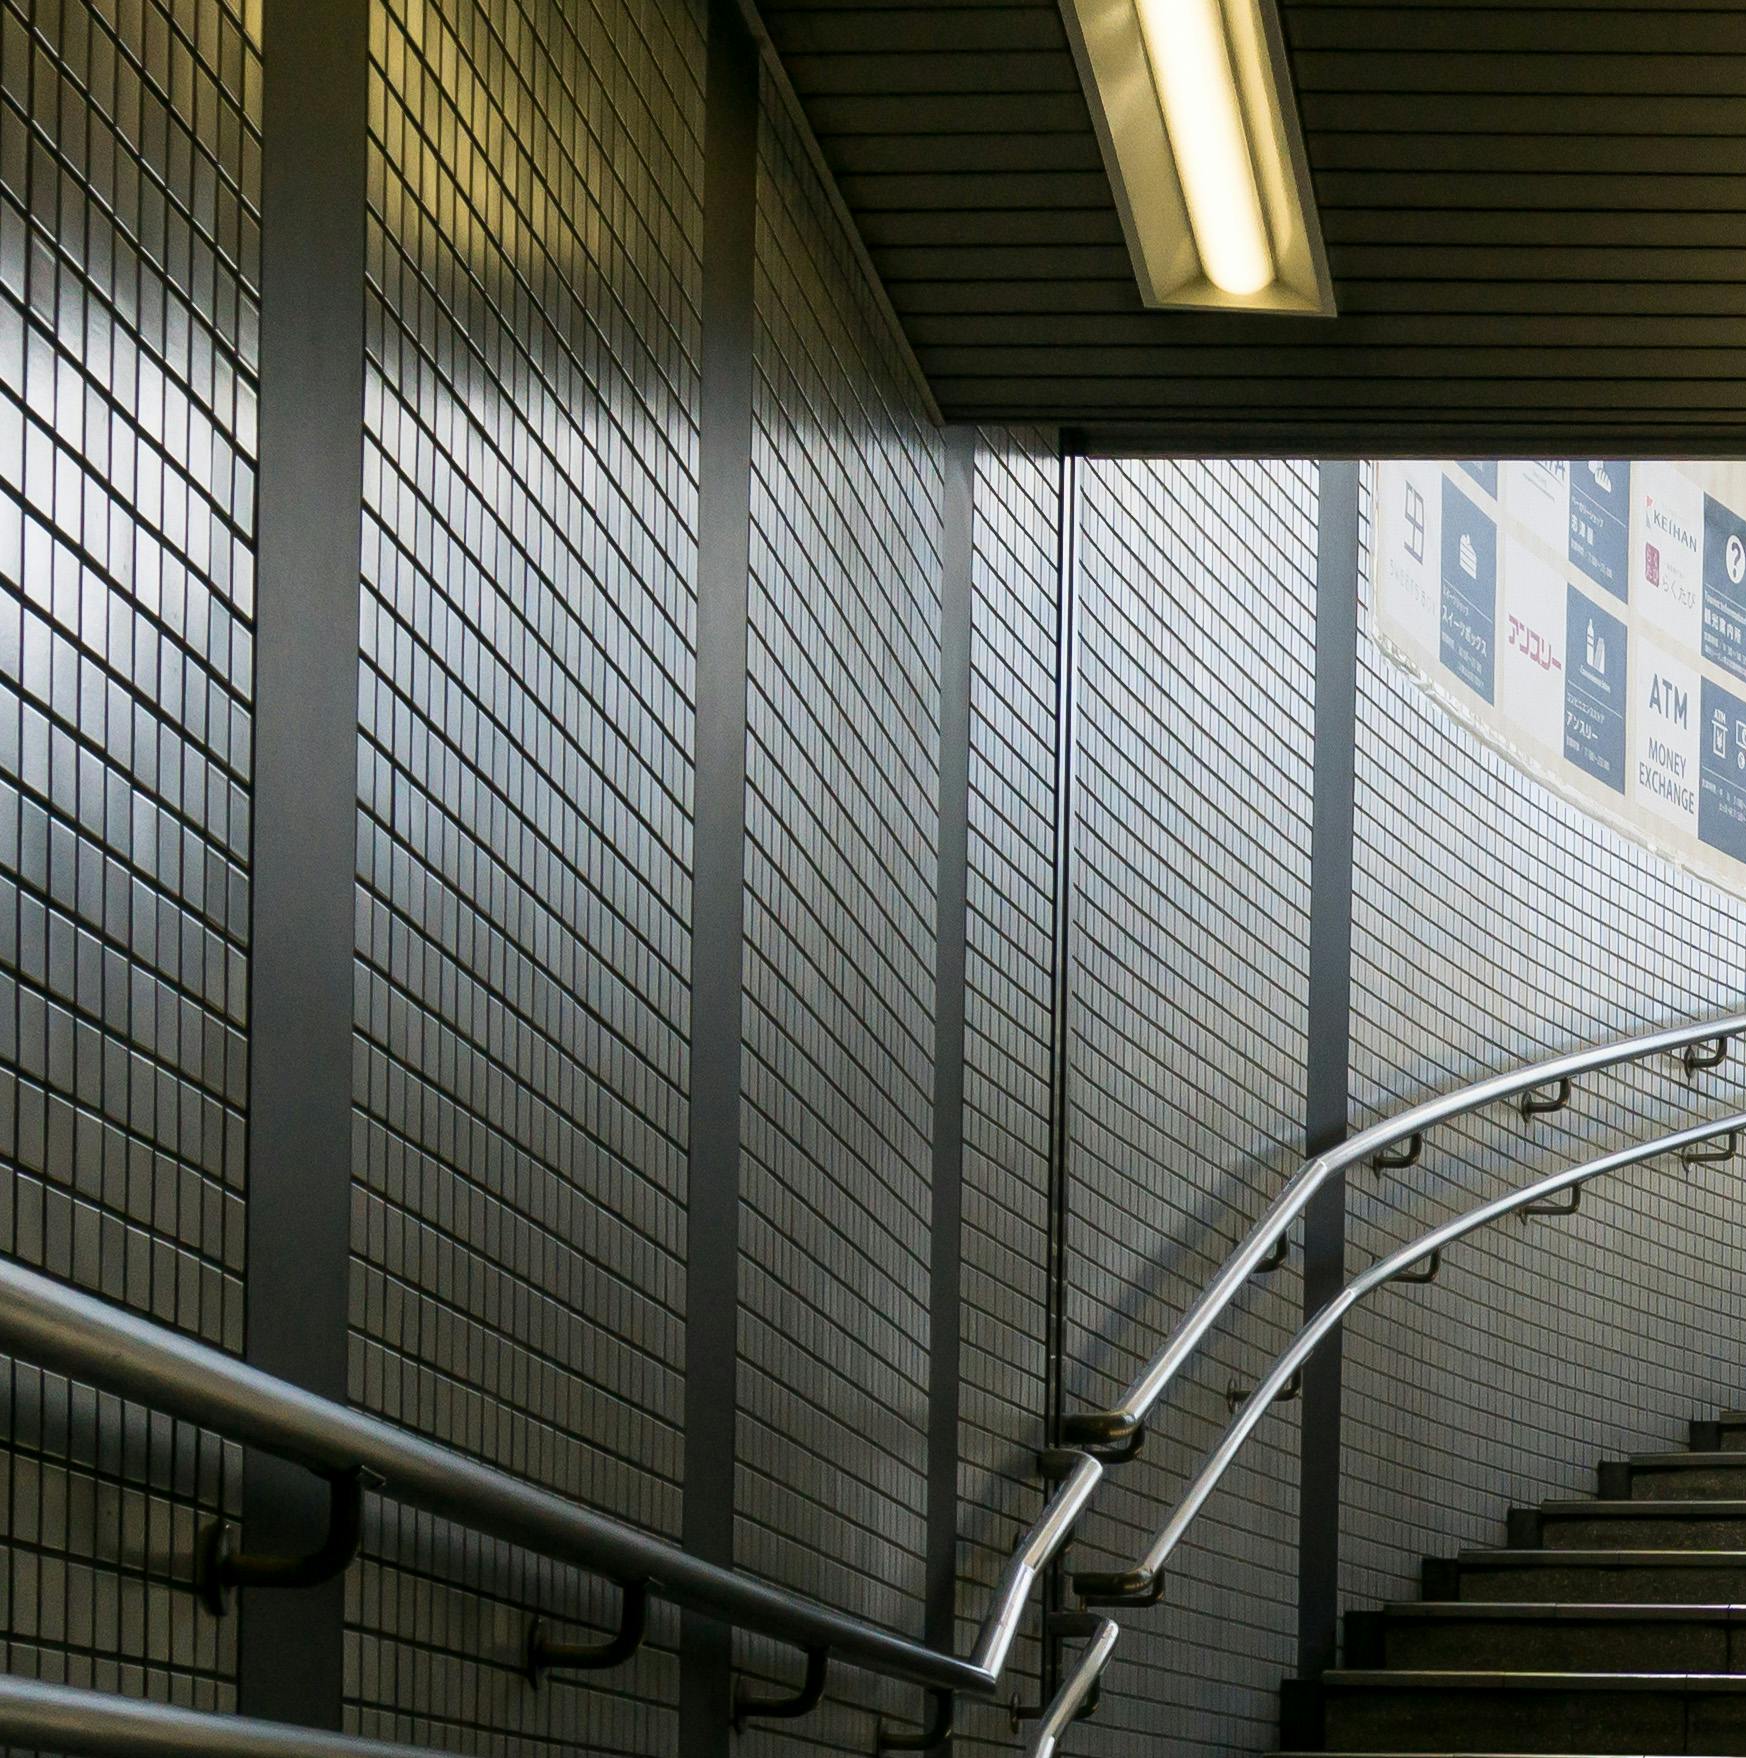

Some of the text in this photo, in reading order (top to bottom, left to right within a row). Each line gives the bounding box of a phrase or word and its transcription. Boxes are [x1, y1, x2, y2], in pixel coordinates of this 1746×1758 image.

[1653, 509, 1698, 553] KEIHAN
[1649, 673, 1688, 731] ATM
[1714, 708, 1727, 725] ATM
[1648, 736, 1687, 779] MONEY
[1639, 761, 1695, 815] EXCHANGE
